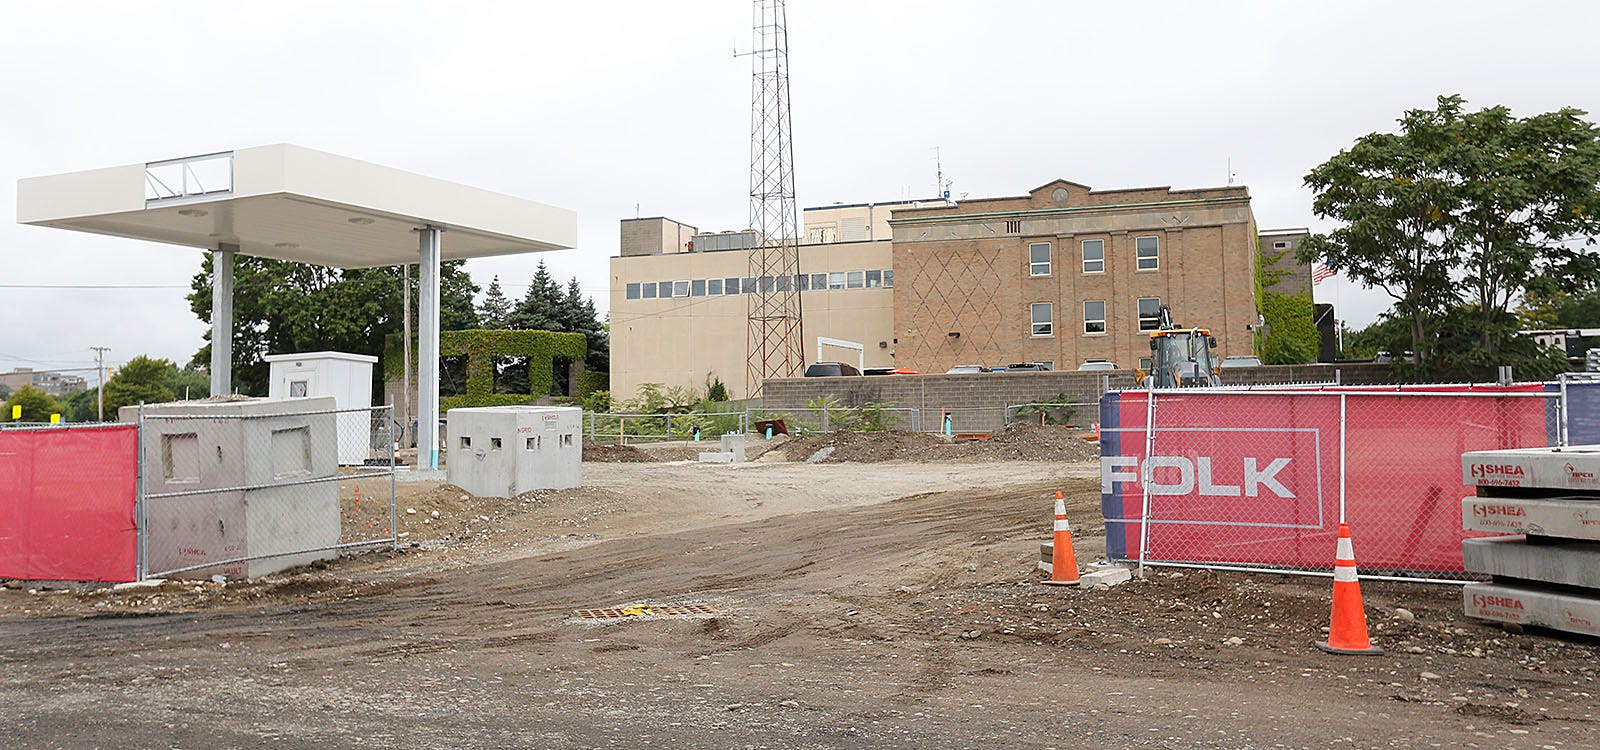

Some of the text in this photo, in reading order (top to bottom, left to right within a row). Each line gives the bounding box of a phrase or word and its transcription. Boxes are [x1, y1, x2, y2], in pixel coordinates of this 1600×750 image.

[1486, 464, 1524, 475] SHEA
[1101, 456, 1296, 498] FOLK
[1488, 505, 1526, 516] SHEA
[1487, 595, 1524, 609] SHEA
